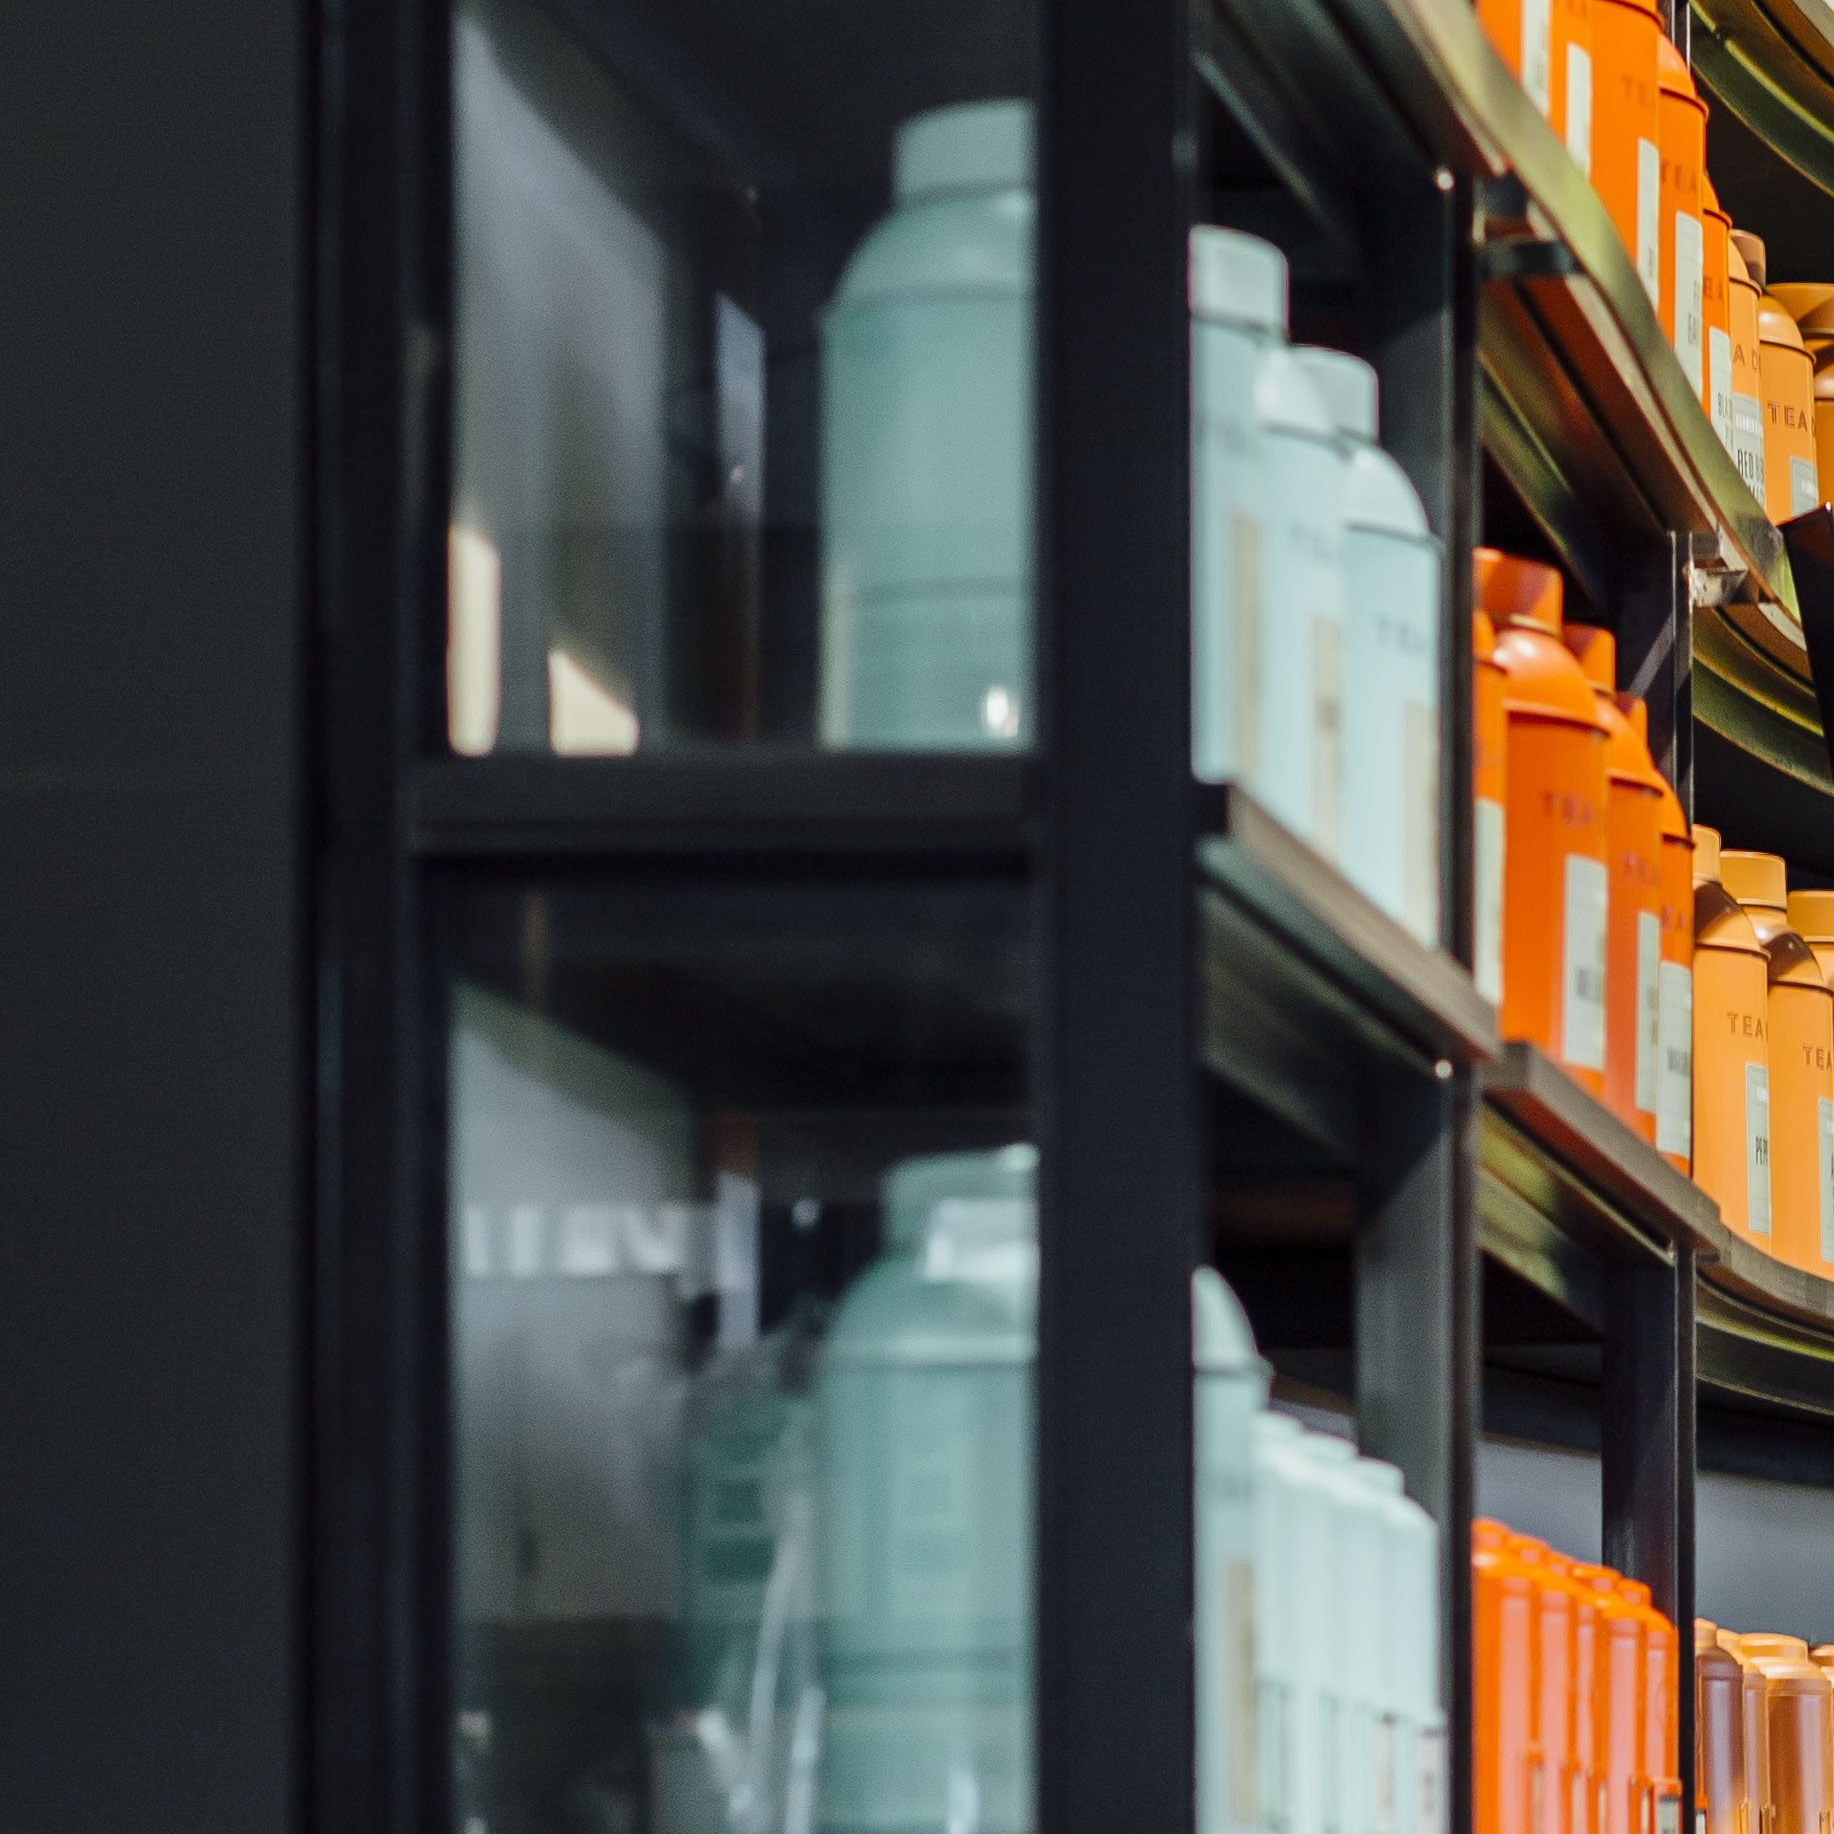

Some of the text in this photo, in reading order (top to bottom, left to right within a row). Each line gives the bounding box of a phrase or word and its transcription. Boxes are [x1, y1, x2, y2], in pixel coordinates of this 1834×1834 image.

[1767, 401, 1808, 433] TEA
[1728, 1013, 1765, 1041] TEA
[1803, 1045, 1832, 1070] TEA
